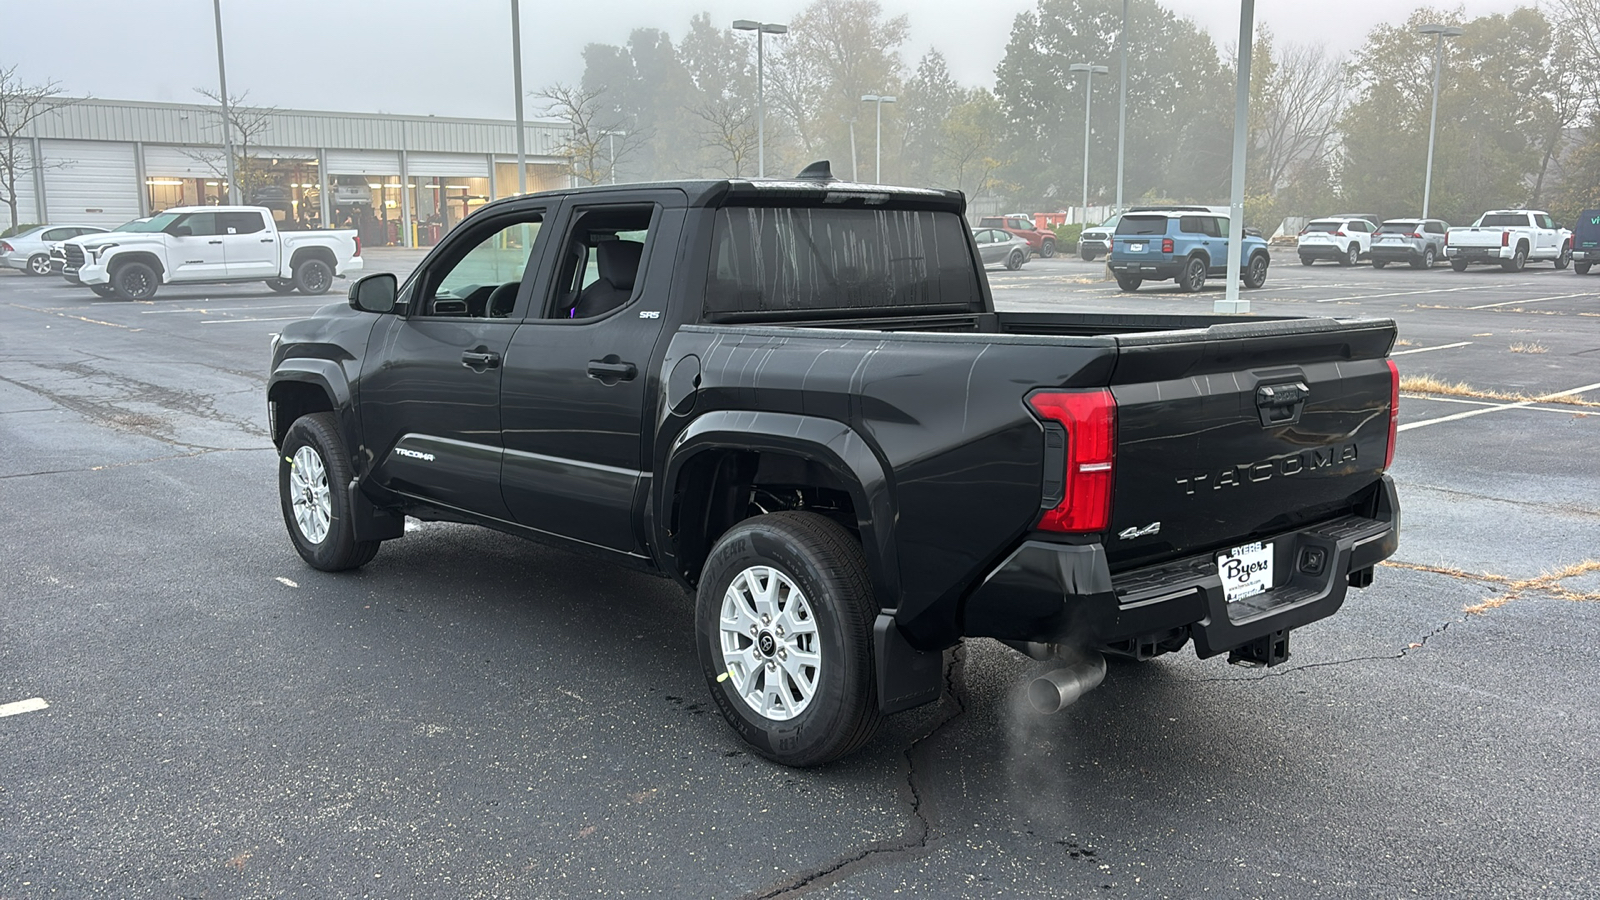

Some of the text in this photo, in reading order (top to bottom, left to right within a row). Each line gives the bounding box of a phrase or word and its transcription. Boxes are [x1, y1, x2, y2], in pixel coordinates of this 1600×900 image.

[394, 447, 435, 462] TACOMA
[1175, 443, 1358, 494] TACOMA
[1222, 559, 1268, 583] Byers
